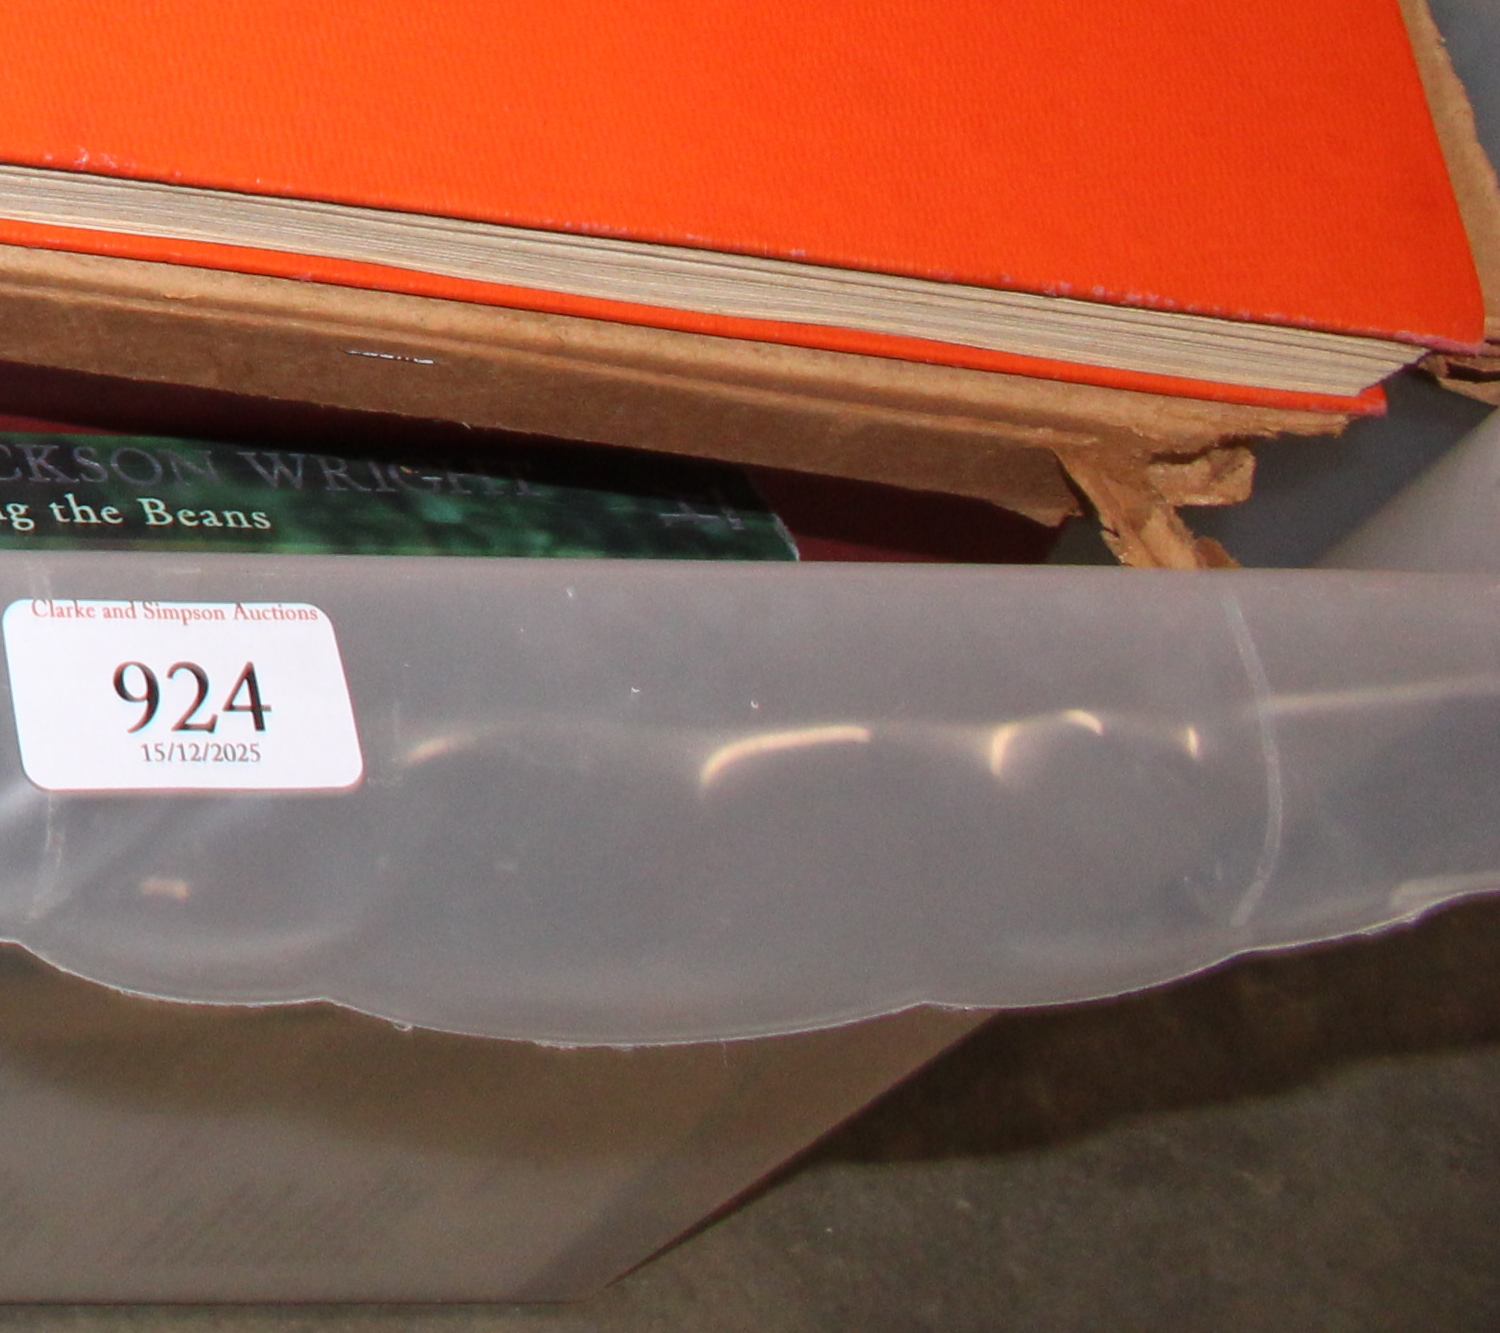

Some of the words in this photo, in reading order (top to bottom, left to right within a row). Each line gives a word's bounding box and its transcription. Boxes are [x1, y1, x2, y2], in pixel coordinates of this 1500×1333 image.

[51, 493, 123, 526] the
[144, 496, 272, 531] Beans
[30, 598, 97, 620] Clarke
[102, 600, 137, 620] and
[143, 601, 226, 626] Simpson
[232, 602, 319, 622] Auctions
[113, 660, 273, 733] 924
[140, 742, 262, 764] 15/12/2025
